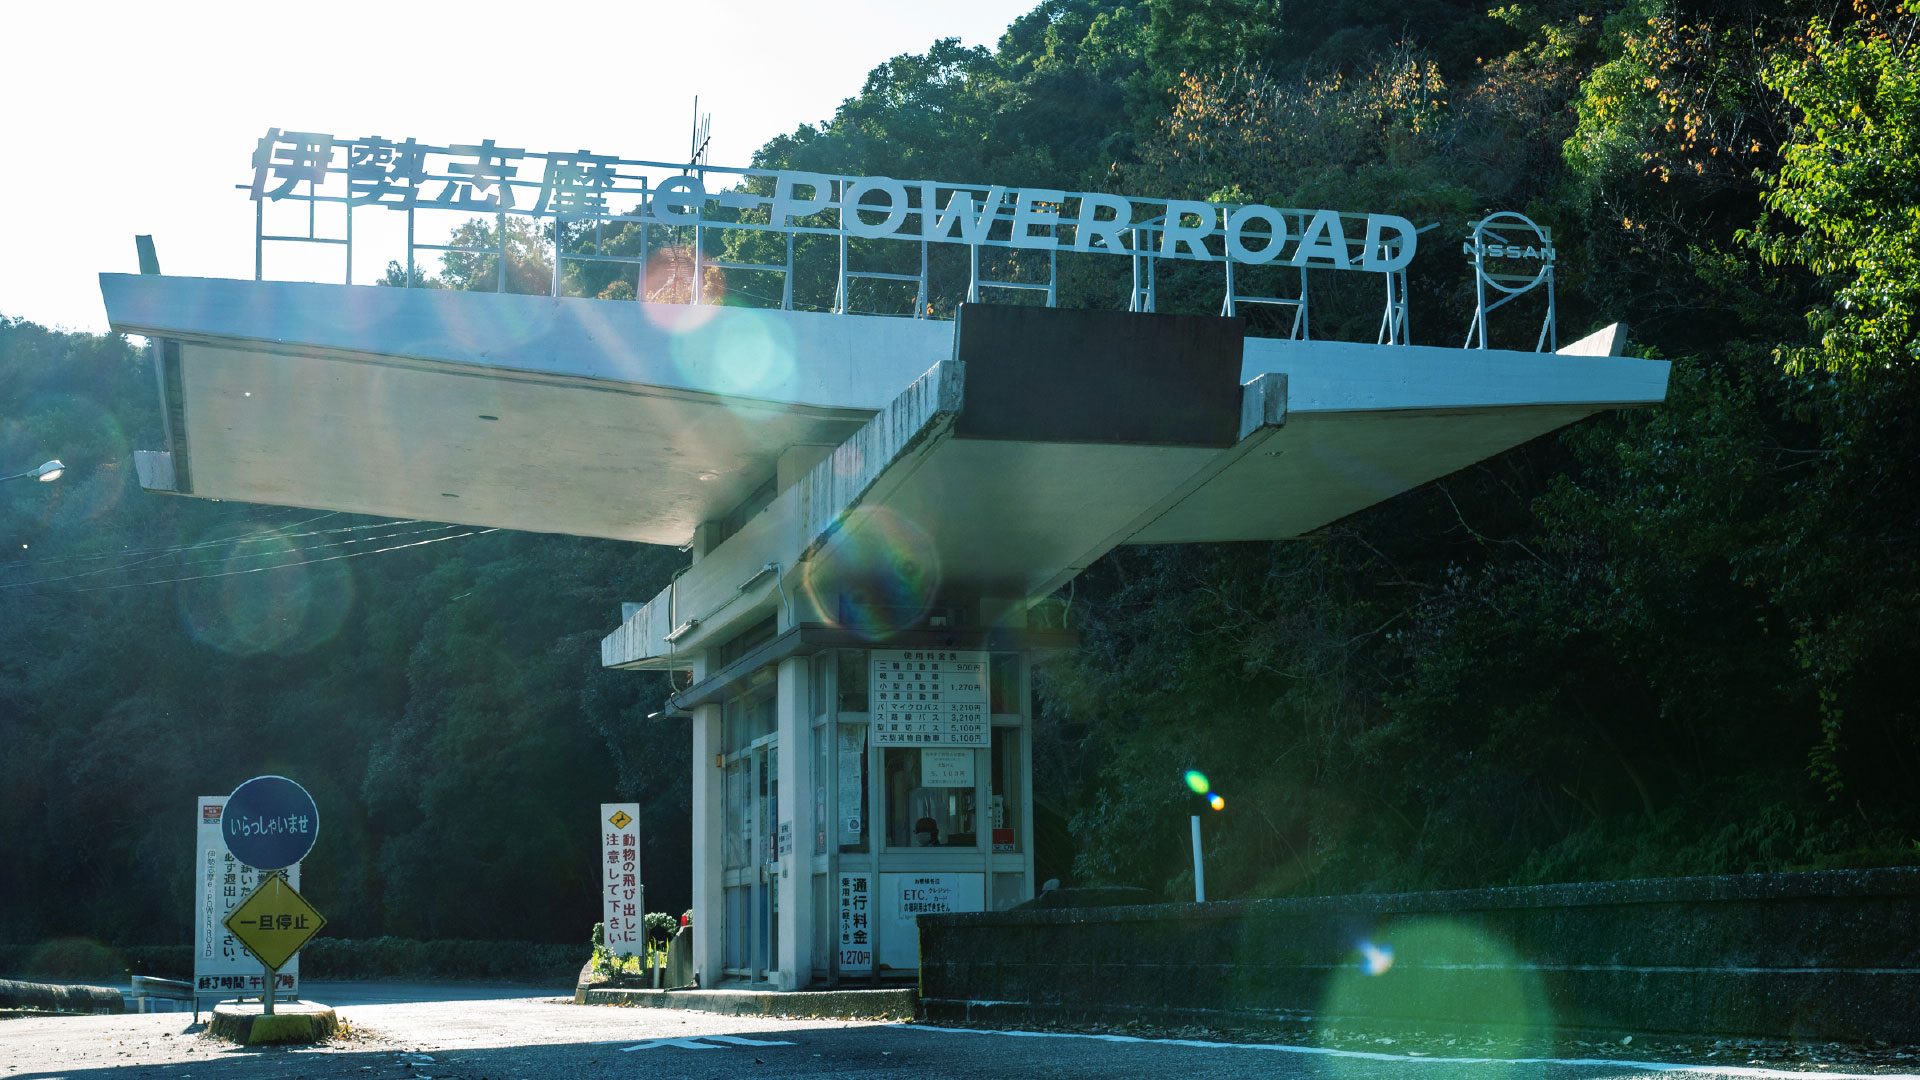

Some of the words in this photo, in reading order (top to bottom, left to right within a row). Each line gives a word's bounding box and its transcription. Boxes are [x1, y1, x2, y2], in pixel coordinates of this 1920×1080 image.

[249, 127, 622, 220] 伊勢志摩
[652, 169, 1132, 255] e-POWER
[1160, 198, 1418, 273] ROAD
[1463, 242, 1556, 261] NISSAN
[957, 663, 981, 672] 900円
[951, 684, 981, 692] 1,270円
[879, 693, 939, 701] 普通自動車
[951, 704, 981, 712] 3,210円
[951, 714, 981, 722] 3,210円
[951, 724, 981, 732] 5,100円
[880, 734, 940, 742] 大型貨物自動車
[951, 734, 981, 742] 5,100円
[231, 814, 309, 837] いらっしゃいませ
[606, 833, 621, 944] 注意して下さい
[622, 833, 636, 943] 動物の飛び出しに
[852, 877, 868, 945] 通行料金
[240, 914, 310, 931] 一旦停止
[198, 976, 245, 990] 終了時間
